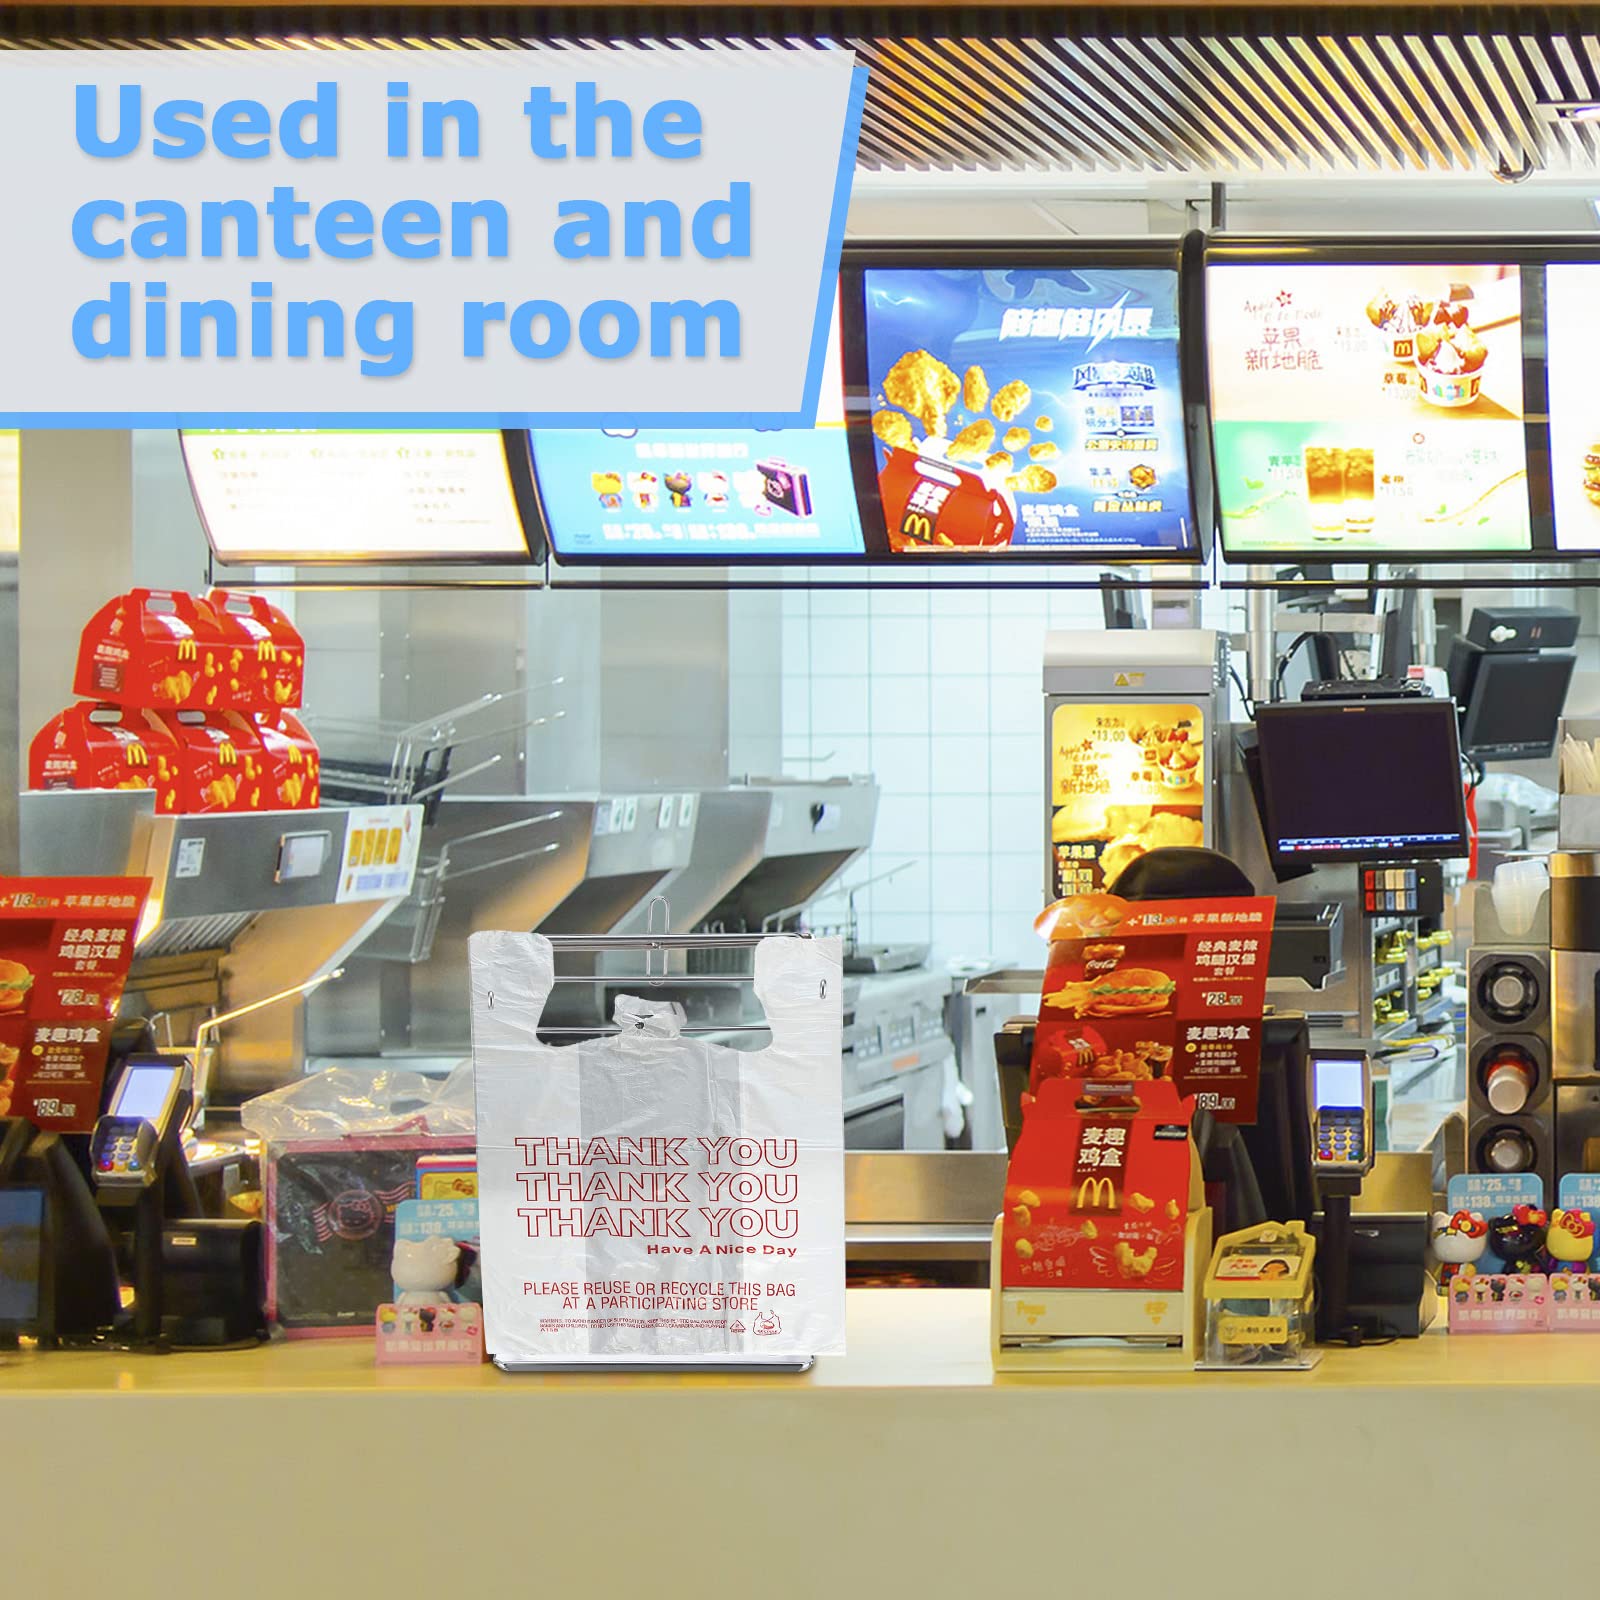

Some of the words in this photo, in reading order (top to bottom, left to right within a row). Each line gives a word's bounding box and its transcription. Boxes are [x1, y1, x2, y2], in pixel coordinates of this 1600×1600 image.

[1262, 327, 1302, 351] 苹果
[1195, 953, 1257, 967] 鸡腿汉堡
[1186, 1025, 1251, 1041] 麦趣鸡盒
[1082, 1126, 1127, 1146] 麦趣
[514, 1136, 689, 1167] THANK
[697, 1136, 798, 1169] YOU
[1078, 1146, 1123, 1167] 鸡盒
[516, 1171, 691, 1203] THANK
[697, 1171, 799, 1204] YOU
[517, 1206, 692, 1238] THANK
[698, 1207, 799, 1239] YOU
[647, 1244, 694, 1255] Have
[699, 1244, 711, 1255] A
[716, 1244, 757, 1255] Nice
[762, 1244, 798, 1258] Day
[523, 1281, 579, 1296] PLEASE
[583, 1281, 632, 1296] REUSE
[635, 1281, 656, 1295] OR
[660, 1281, 725, 1297] RECYCLE
[728, 1281, 762, 1297] THIS
[766, 1283, 796, 1297] BAG
[562, 1296, 580, 1310] AT
[586, 1297, 596, 1310] A
[600, 1296, 708, 1311] PARTICIPATING
[711, 1296, 759, 1311] STORE
